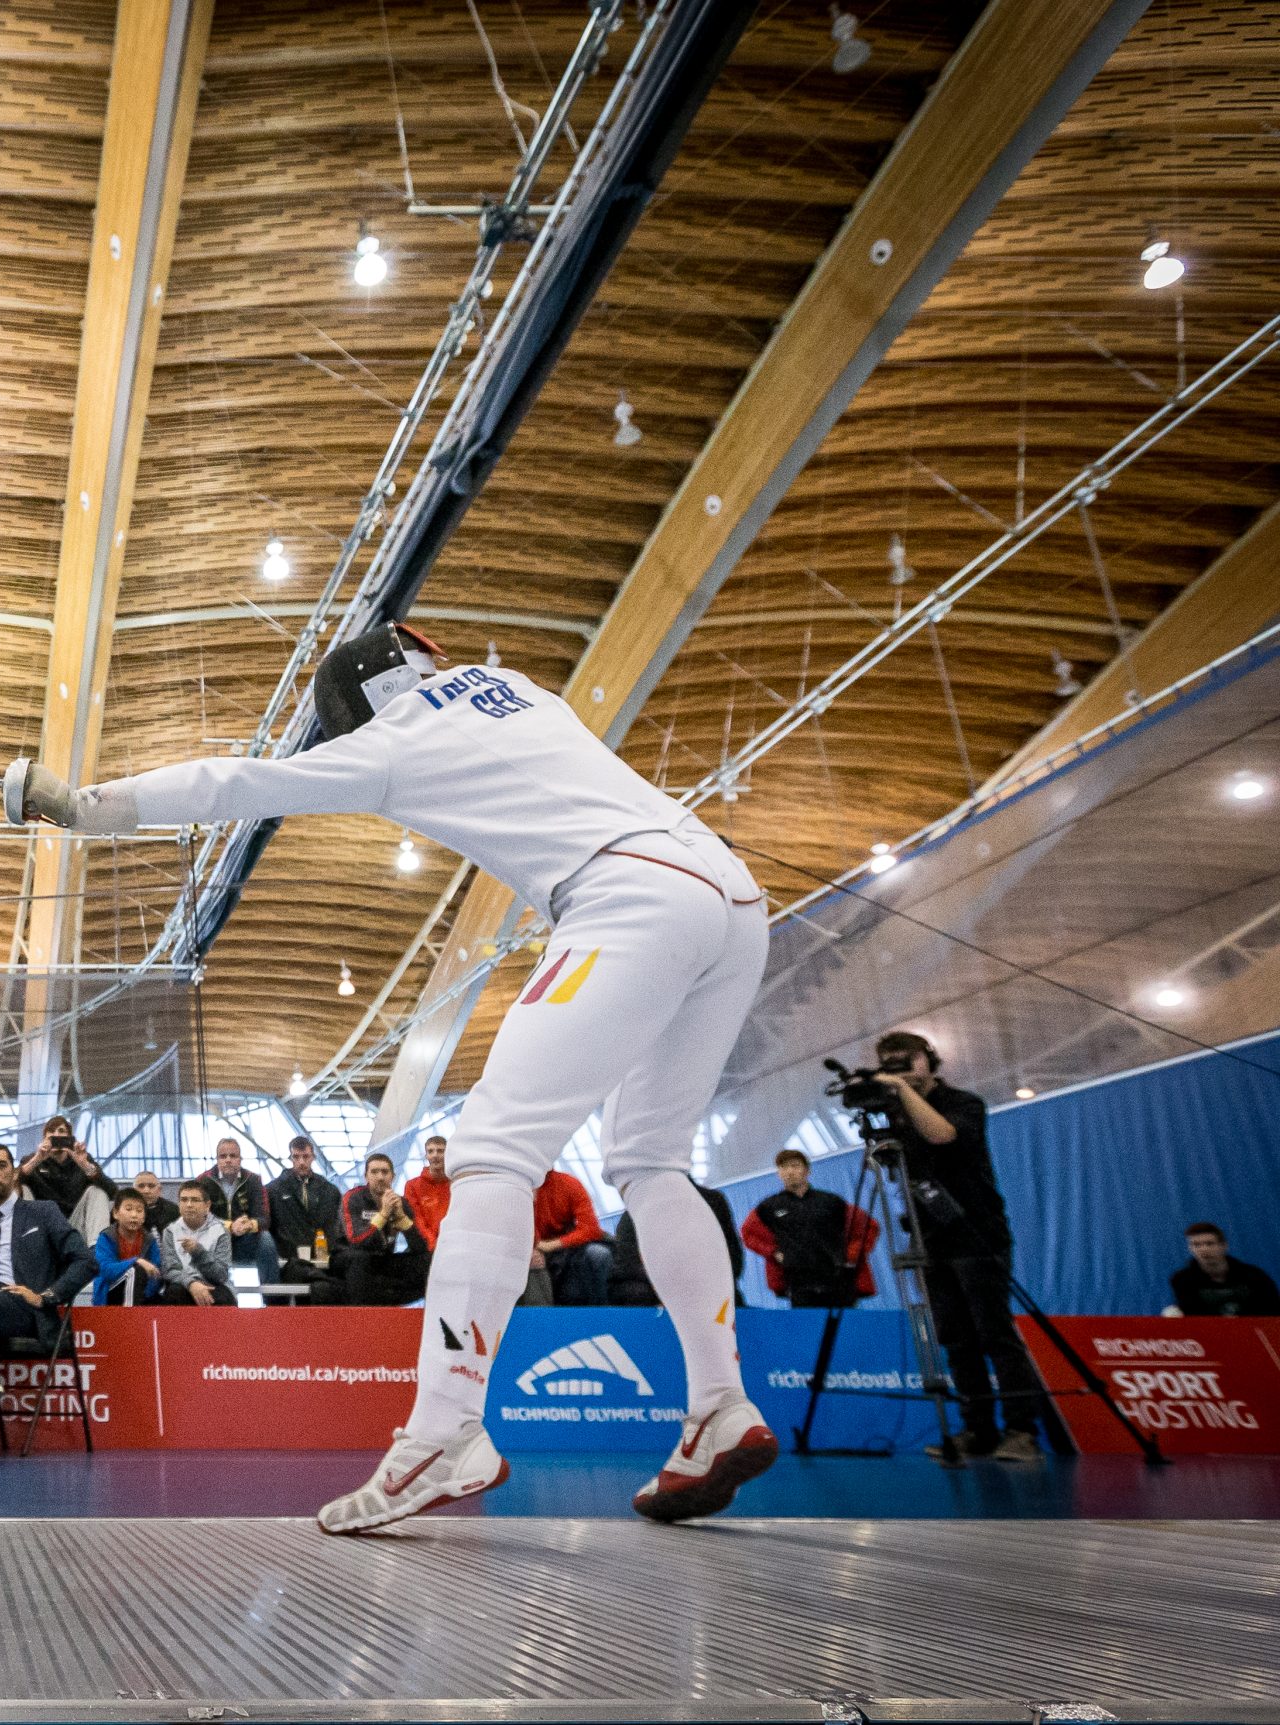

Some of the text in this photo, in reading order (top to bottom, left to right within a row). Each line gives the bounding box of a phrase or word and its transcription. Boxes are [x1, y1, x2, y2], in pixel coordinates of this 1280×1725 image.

[470, 687, 535, 719] GER
[1092, 1338, 1206, 1357] RICHMOND
[1111, 1370, 1224, 1399] SPORT
[500, 1407, 581, 1422] RICHMOND
[584, 1407, 648, 1422] OLYMPIC
[1116, 1400, 1260, 1429] HOSTING
